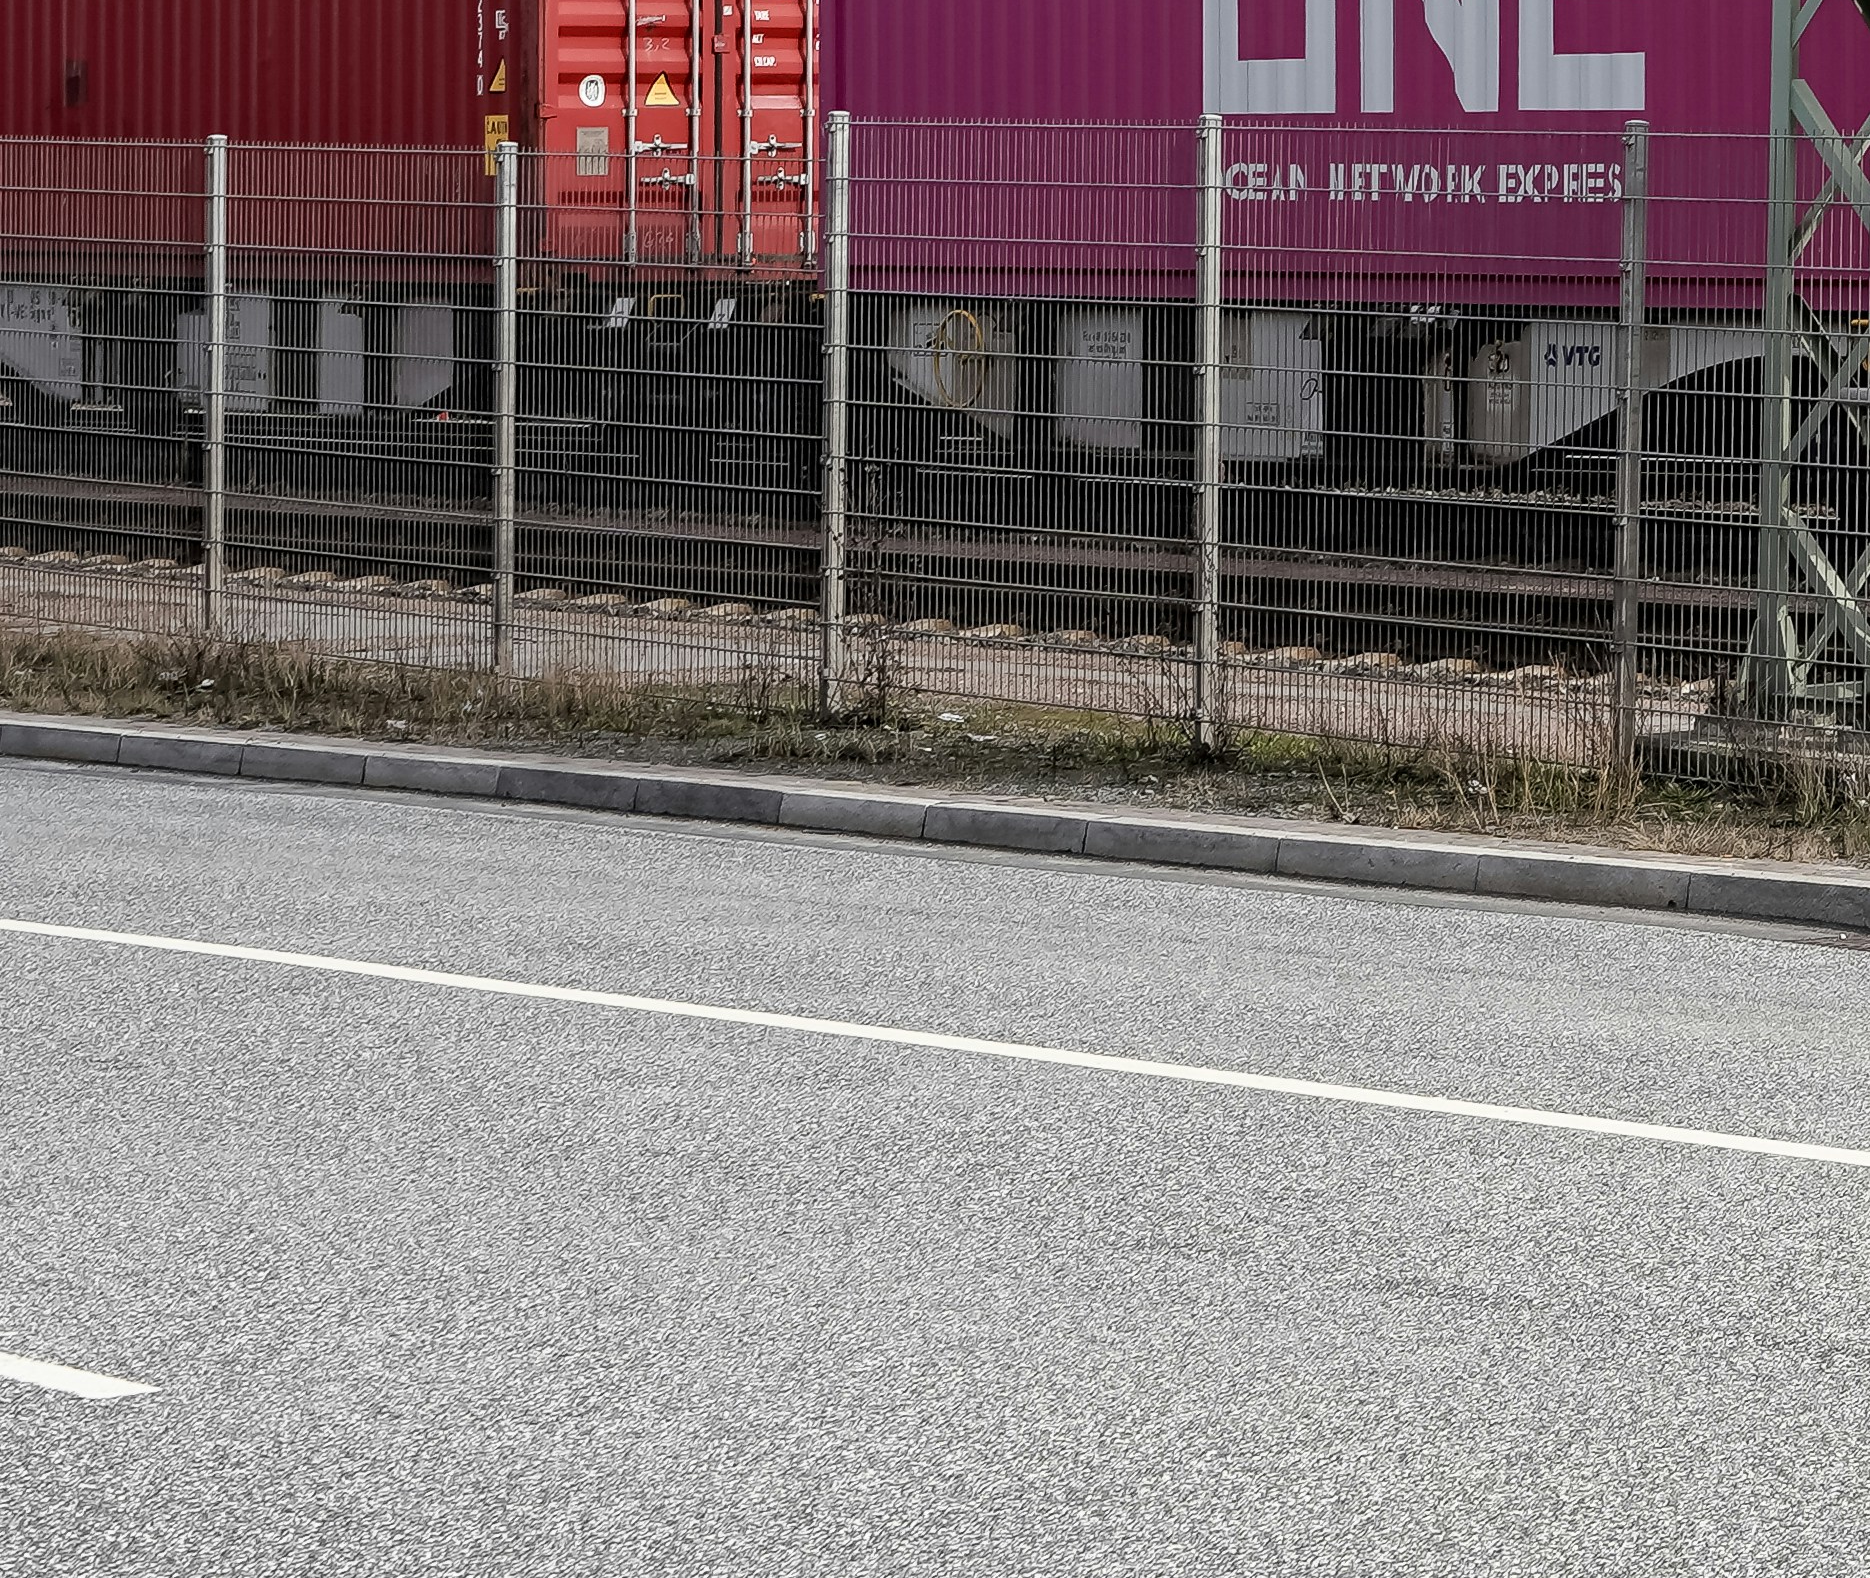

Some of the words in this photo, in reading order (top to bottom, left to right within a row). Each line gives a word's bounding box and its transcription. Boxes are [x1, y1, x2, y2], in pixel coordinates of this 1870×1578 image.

[1222, 163, 1307, 201] CEAN
[1497, 163, 1623, 203] EXPRES
[1563, 345, 1600, 367] VTG
